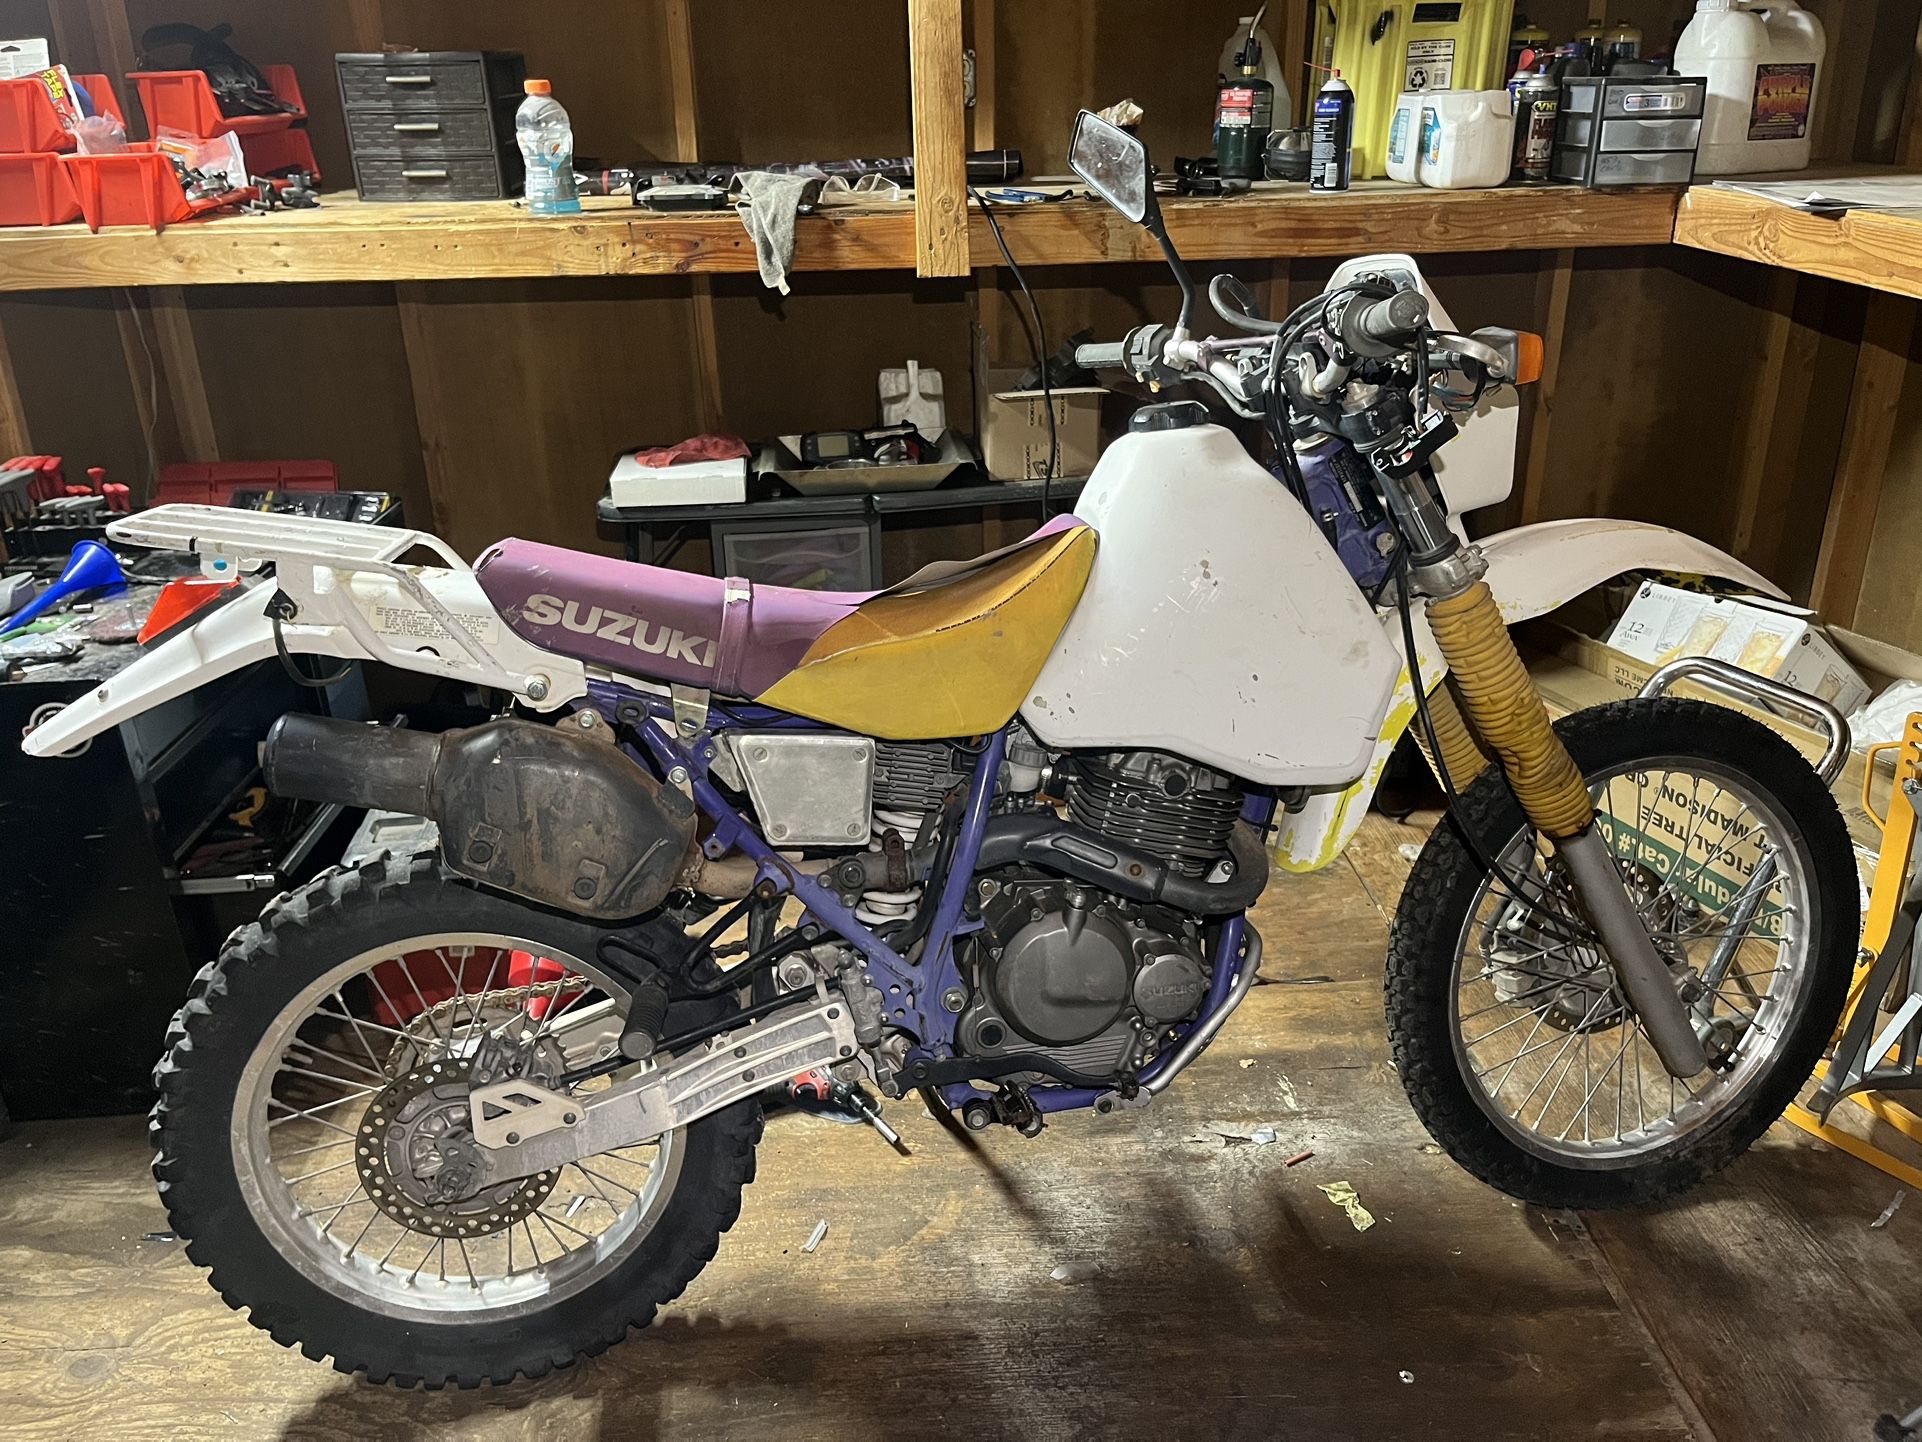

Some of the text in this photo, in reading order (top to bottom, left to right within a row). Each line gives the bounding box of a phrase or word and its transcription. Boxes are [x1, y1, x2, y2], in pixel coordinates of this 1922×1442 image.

[41, 71, 62, 99] TAPE
[46, 69, 64, 98] FLEX
[1537, 101, 1557, 112] VHT
[521, 593, 720, 668] SUZUKI
[1627, 620, 1645, 634] 12
[1614, 665, 1629, 677] LLC
[1784, 670, 1797, 687] 12
[1640, 804, 1688, 842] TREE
[1140, 983, 1200, 999] SUZUKI
